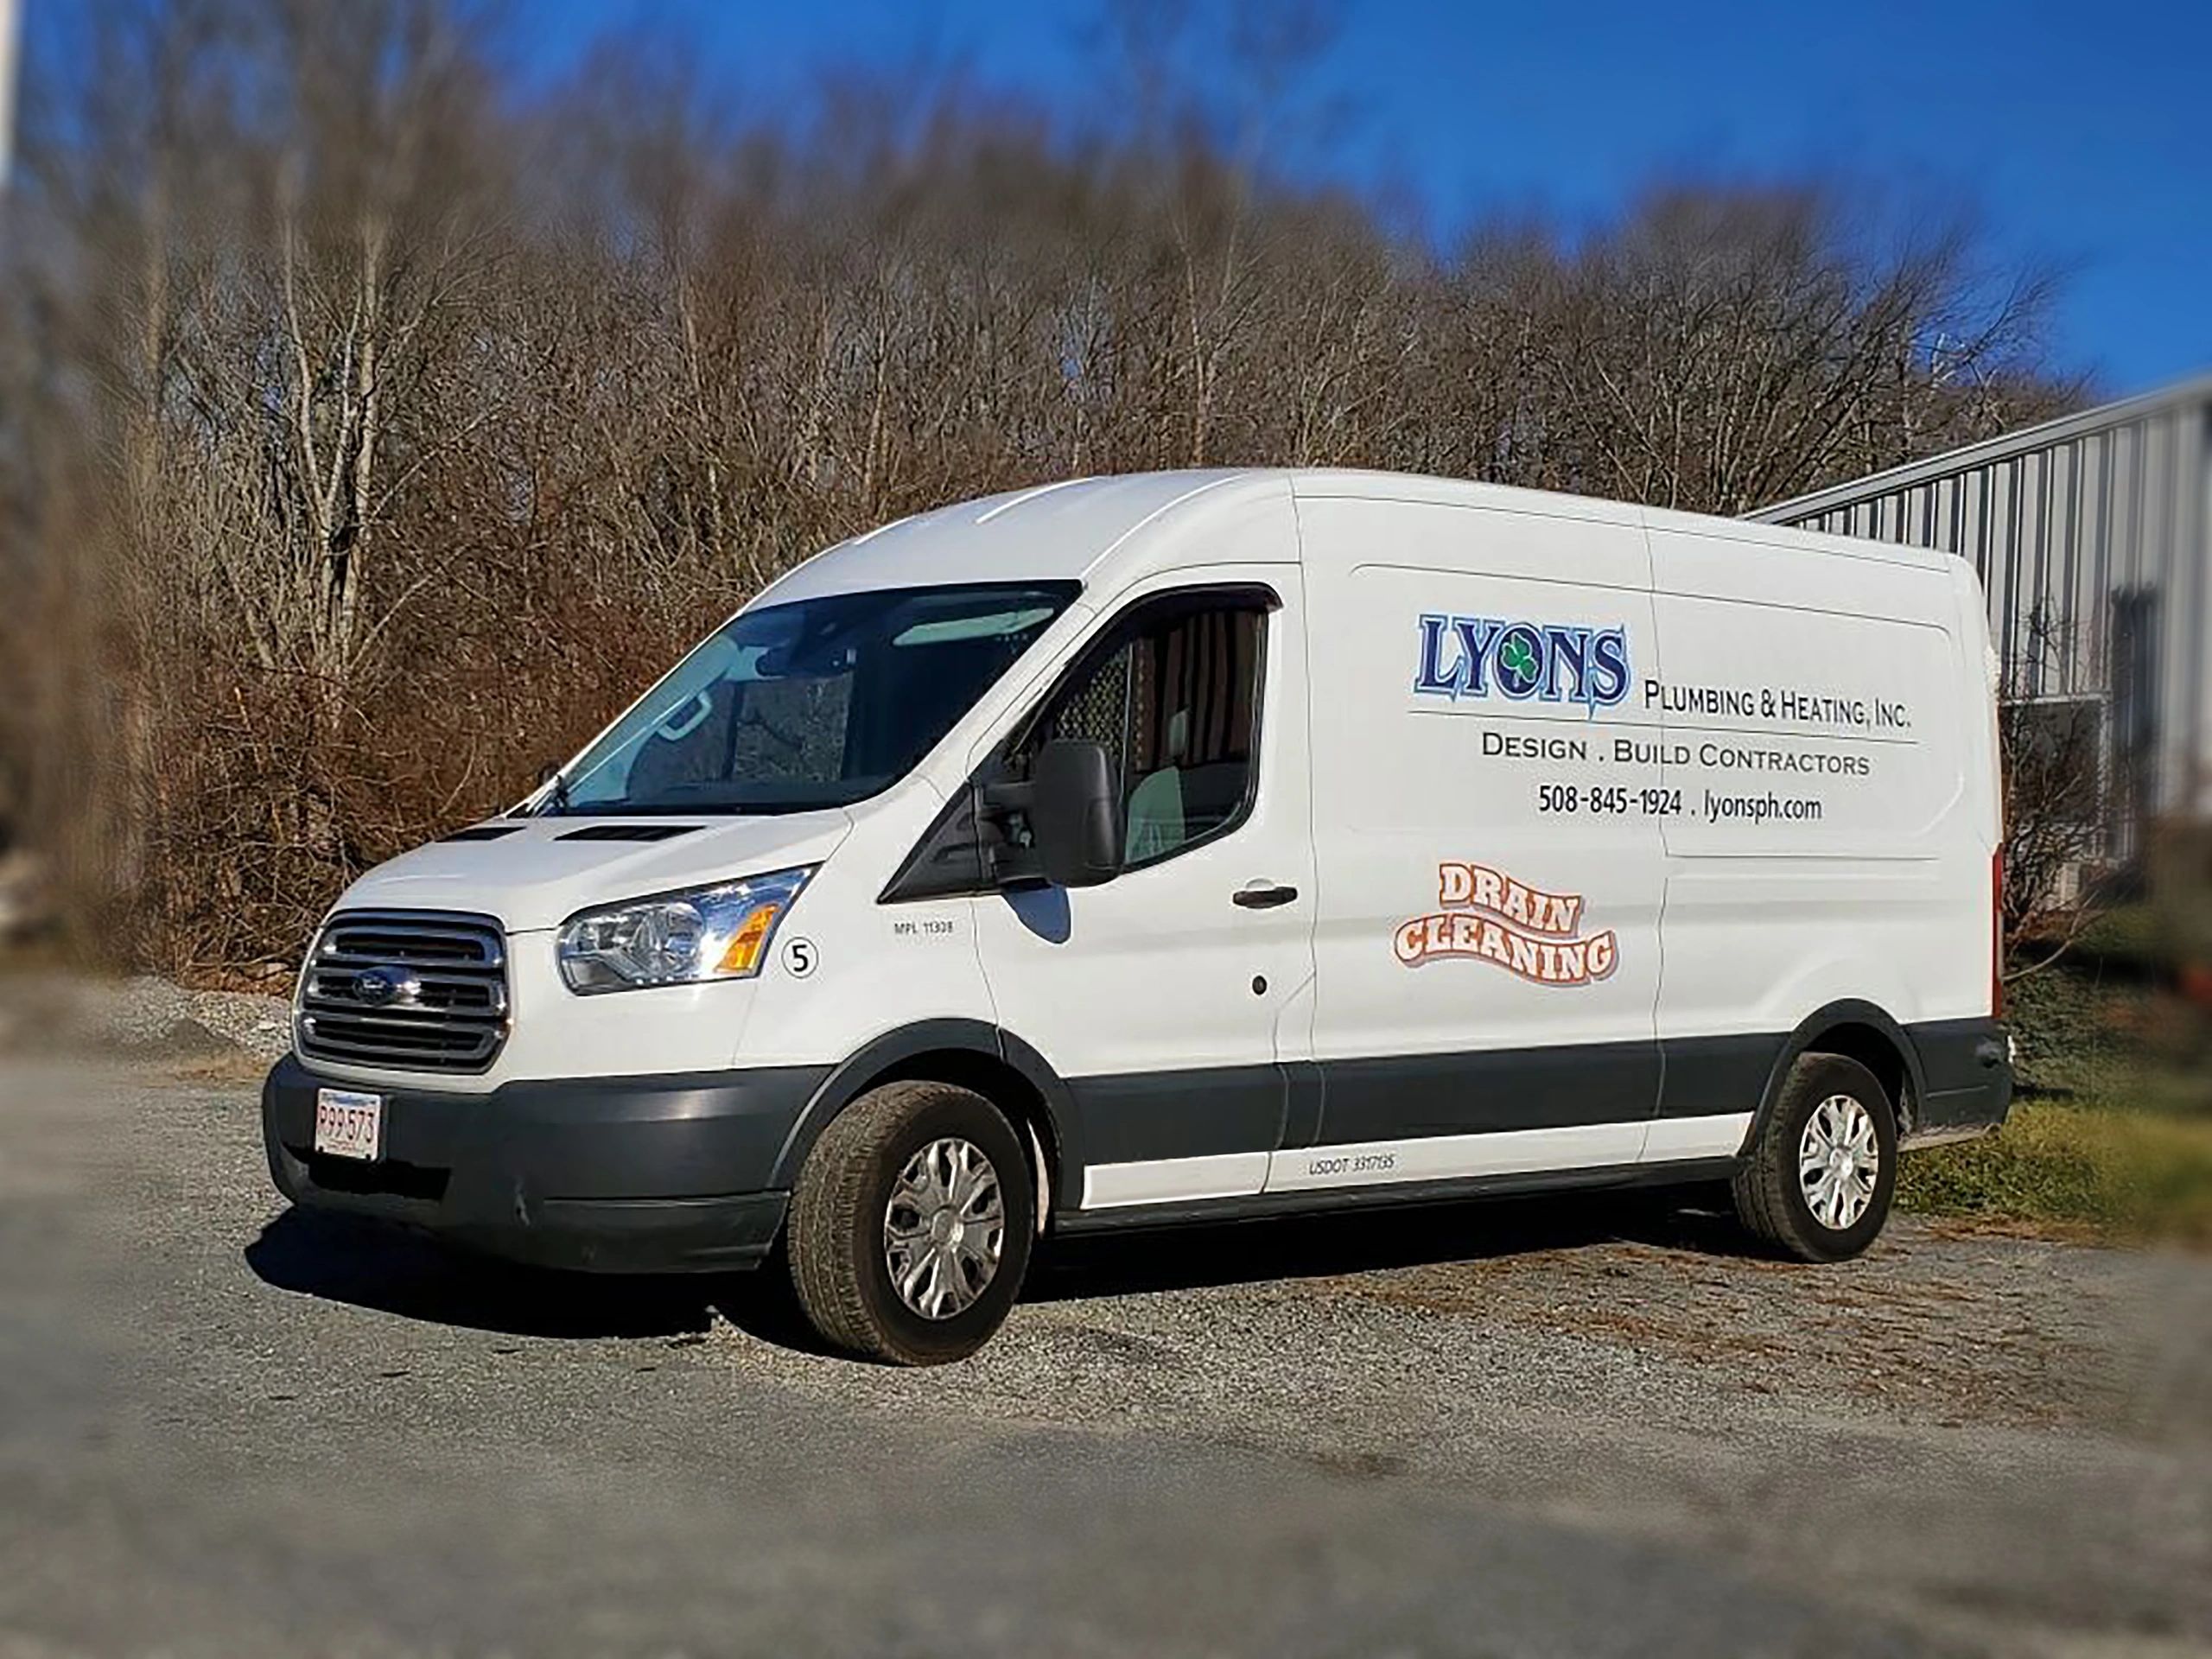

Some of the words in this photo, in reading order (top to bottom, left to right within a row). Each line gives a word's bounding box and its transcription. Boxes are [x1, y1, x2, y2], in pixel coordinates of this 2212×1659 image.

[1414, 614, 1630, 709] LYONS
[1644, 679, 1755, 717] PLUMBING
[1760, 689, 1777, 719] &
[1781, 690, 1872, 730] HEATING,
[1875, 698, 1912, 728] INC.
[1482, 732, 1587, 761] DESIGN
[1614, 740, 1691, 765] BUILD
[1699, 743, 1871, 775] CONTRACTORS
[1538, 785, 1682, 816] 508-845-1924
[1704, 789, 1822, 824] lyonsph.com
[1438, 863, 1585, 937] DRAIN
[791, 944, 810, 973] 5
[1395, 912, 1618, 987] CLEANING
[1309, 1158, 1350, 1175] USDOT
